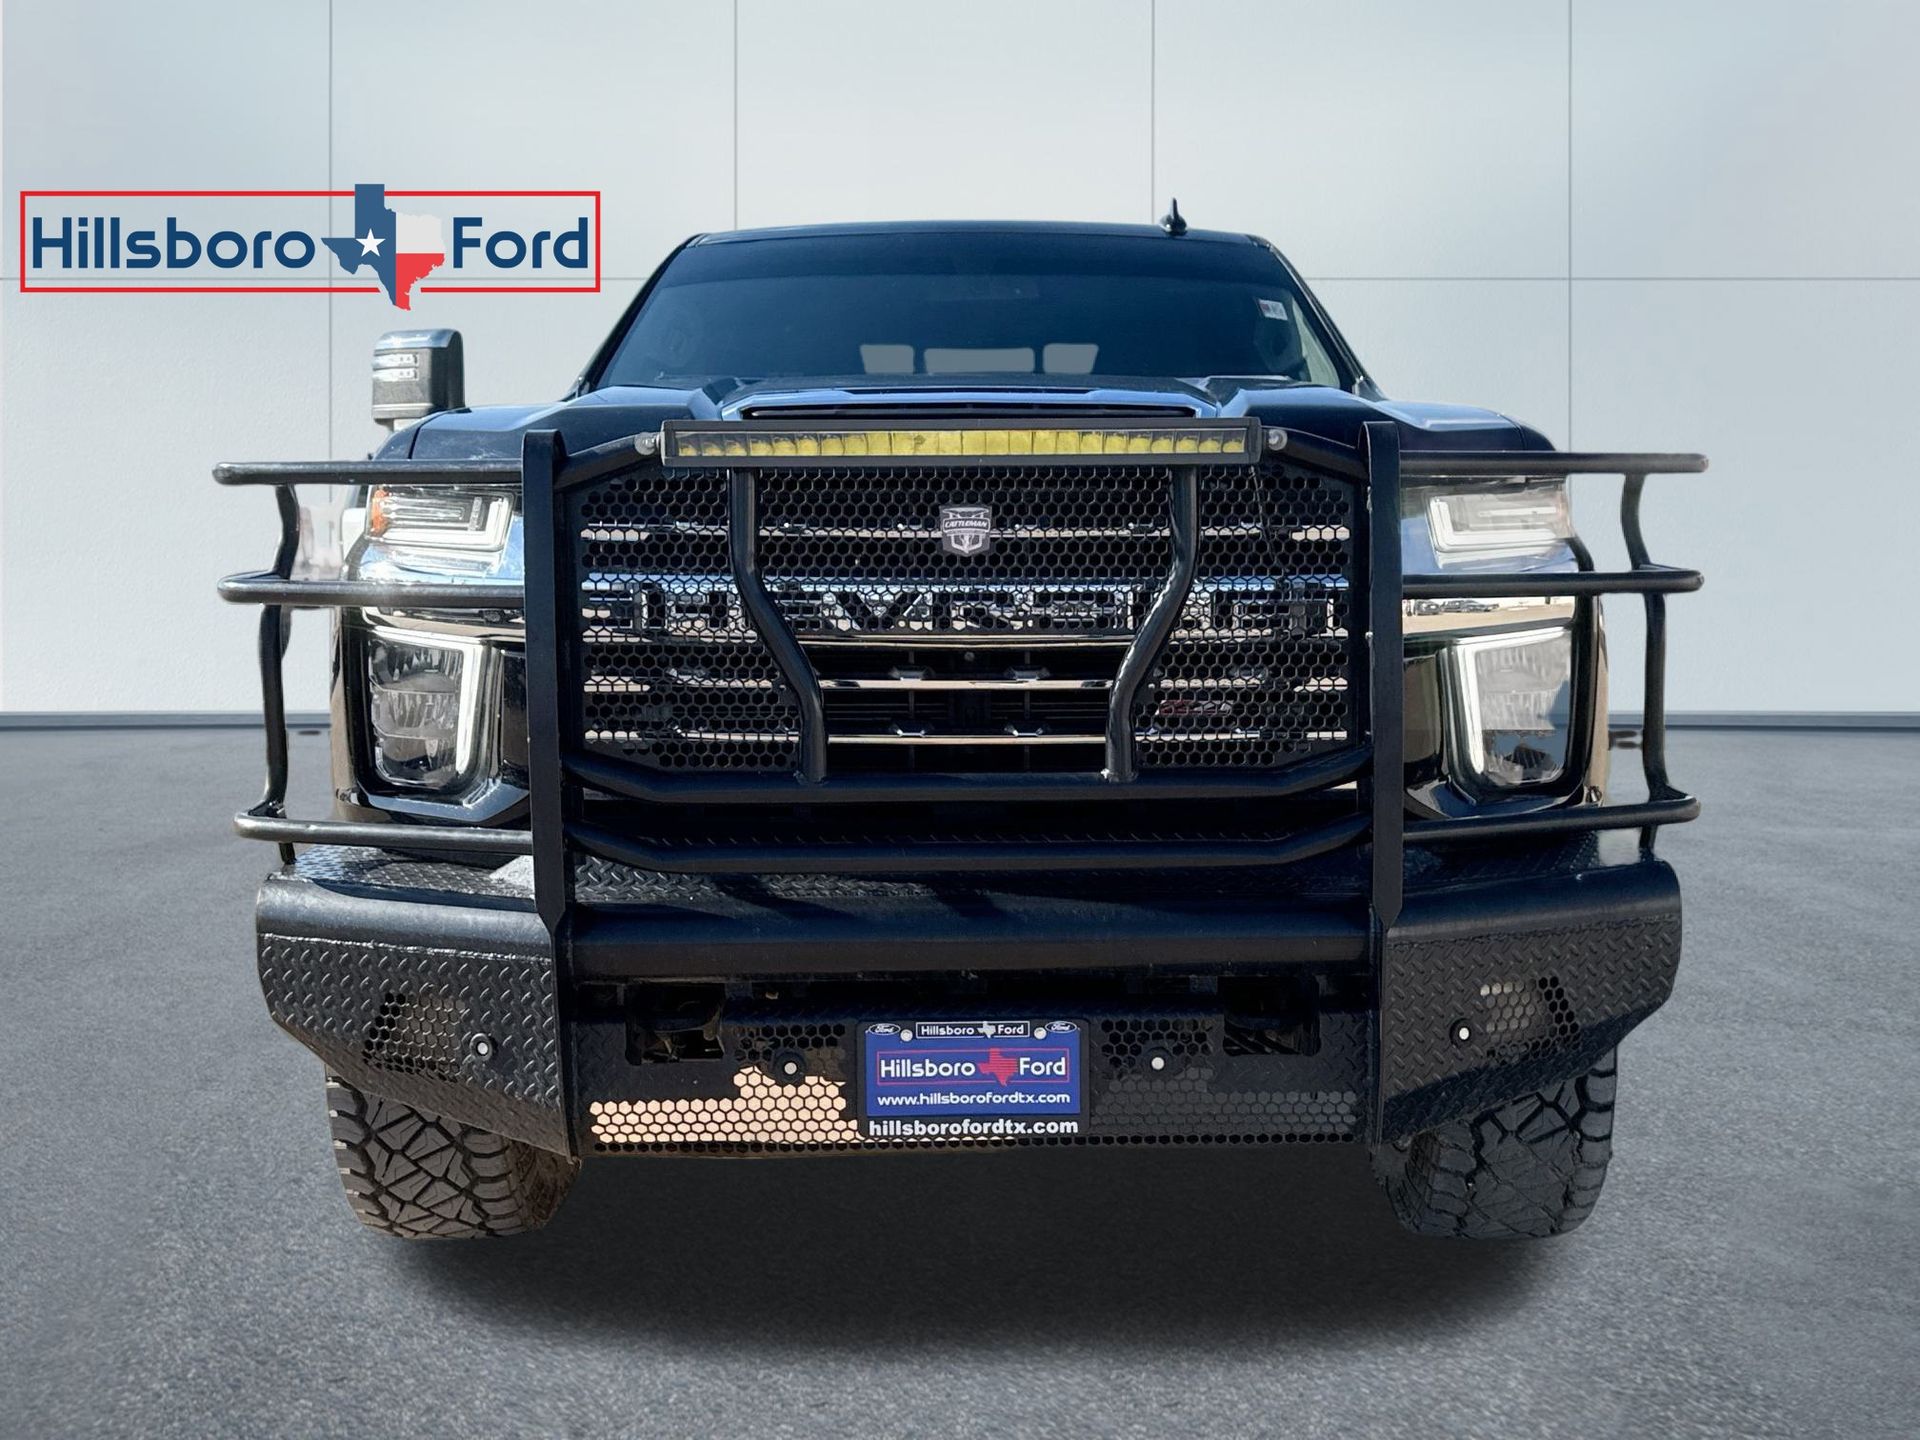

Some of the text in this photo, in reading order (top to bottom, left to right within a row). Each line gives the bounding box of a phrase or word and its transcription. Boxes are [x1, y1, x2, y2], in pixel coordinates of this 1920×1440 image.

[945, 520, 988, 528] CATTLEMAN
[921, 1024, 1024, 1036] Hillsboro Ford
[880, 1057, 1066, 1078] Hillsboro Ford
[877, 1092, 1071, 1106] www.hillsborofordtx.com
[869, 1119, 1079, 1136] hillsborofordtx.com
